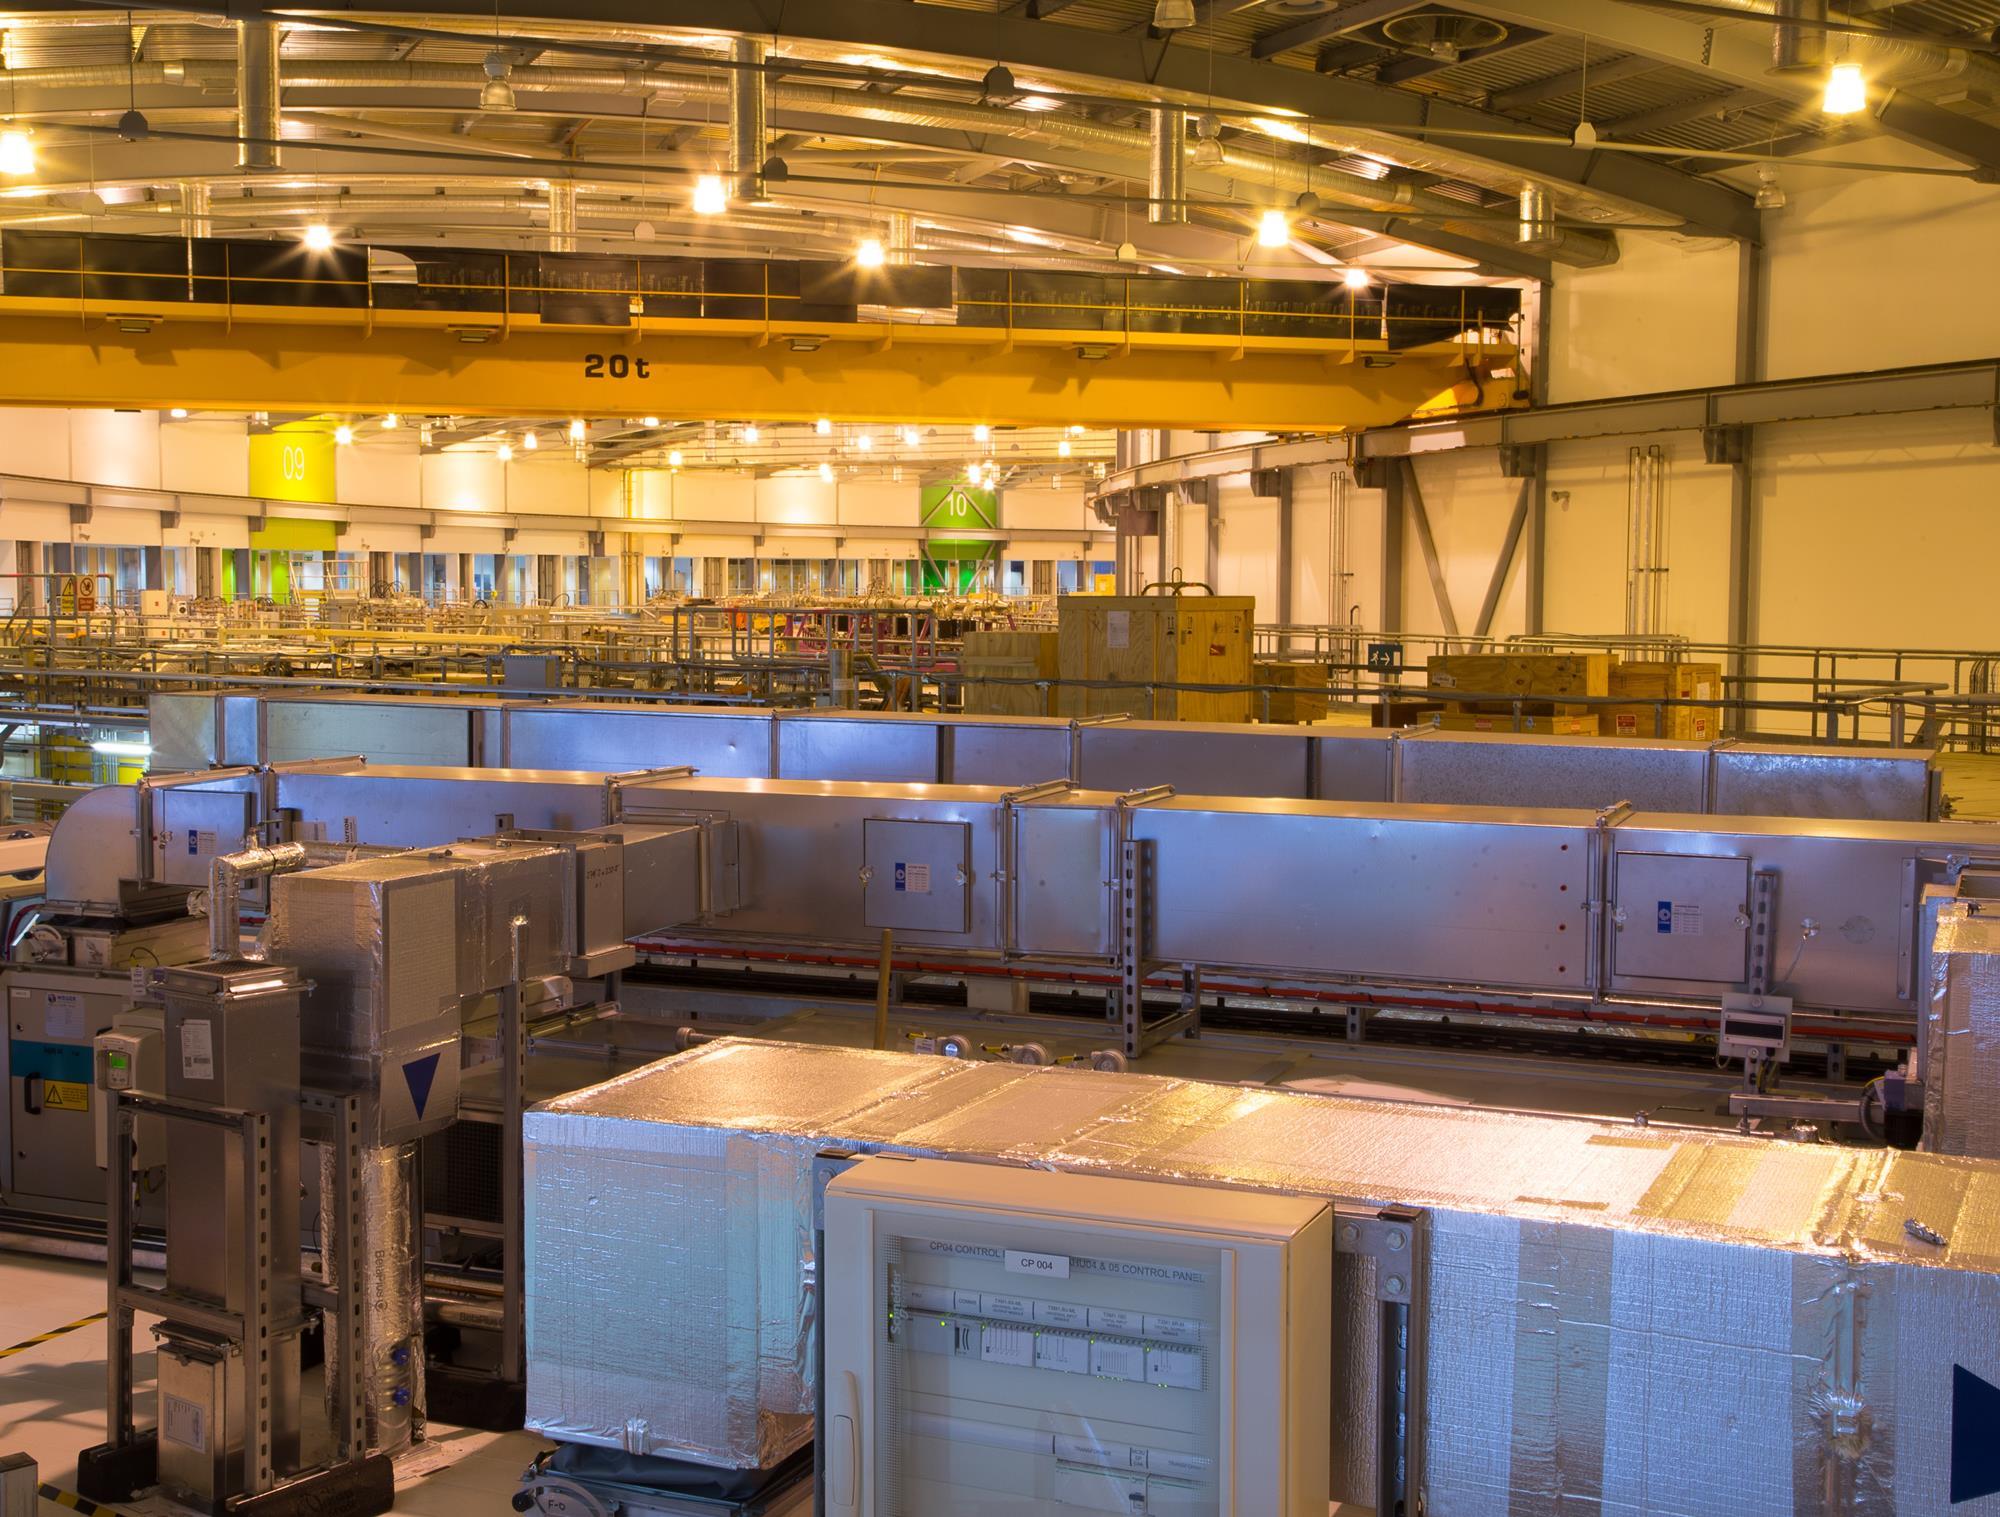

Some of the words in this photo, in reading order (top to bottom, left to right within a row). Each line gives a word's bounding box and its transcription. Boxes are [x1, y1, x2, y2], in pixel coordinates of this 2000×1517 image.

[585, 354, 629, 378] 20
[635, 358, 650, 378] t
[283, 445, 305, 480] 09
[946, 491, 967, 517] 10
[929, 1241, 953, 1252] CP04
[954, 1245, 1001, 1258] CONTROL
[1020, 1258, 1034, 1267] CP
[1036, 1260, 1053, 1270] 004
[1108, 1263, 1119, 1272] 05
[1122, 1265, 1170, 1279] CONTROL
[1172, 1270, 1206, 1283] PANEL
